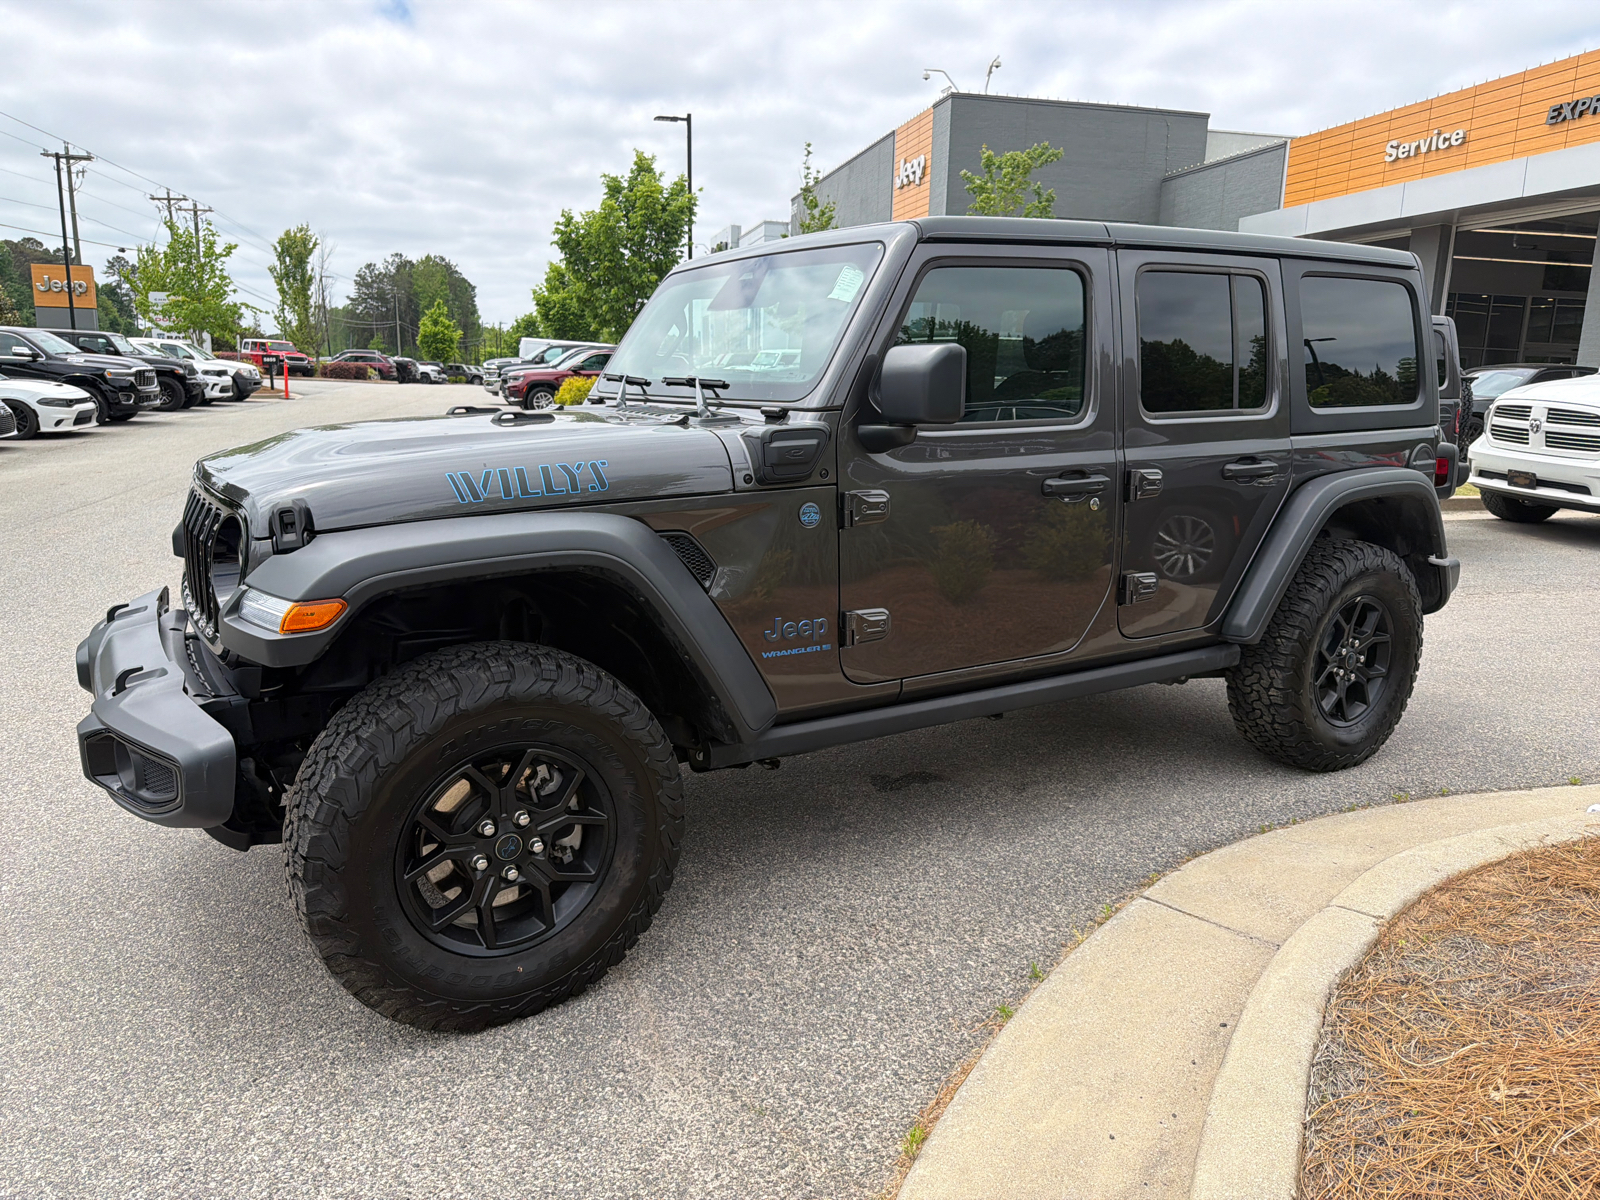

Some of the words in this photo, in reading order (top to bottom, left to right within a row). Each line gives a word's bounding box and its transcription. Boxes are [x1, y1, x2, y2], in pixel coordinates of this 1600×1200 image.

[1384, 129, 1467, 162] Service
[895, 154, 926, 190] Jeep
[35, 275, 88, 297] Jeep
[445, 460, 609, 504] WILLYS
[764, 617, 829, 642] Jeep
[762, 645, 821, 659] WRANGLER
